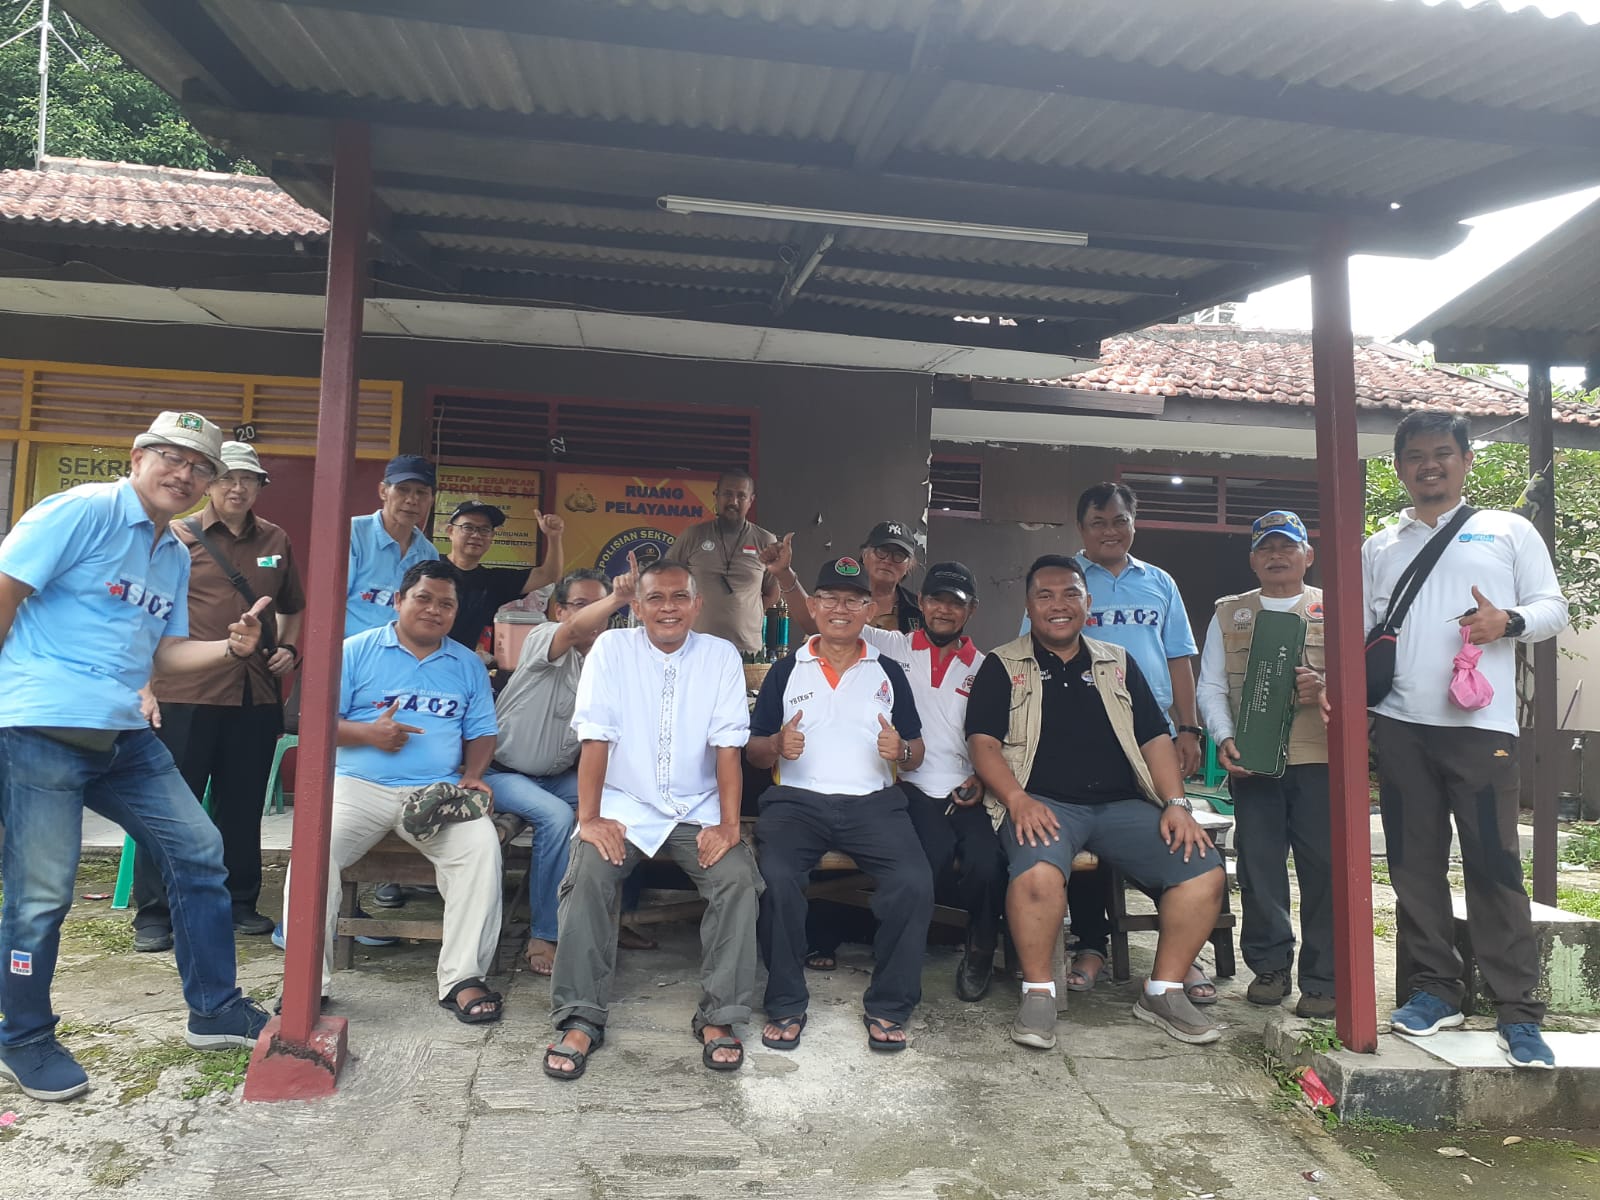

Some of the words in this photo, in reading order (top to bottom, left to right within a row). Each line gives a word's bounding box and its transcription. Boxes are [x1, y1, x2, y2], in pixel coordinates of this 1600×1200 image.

[236, 425, 256, 441] 20
[549, 436, 566, 454] 22
[440, 474, 474, 483] TETAP
[477, 476, 535, 486] TERAPKAN
[438, 483, 503, 497] PROKES
[524, 487, 537, 500] M
[625, 484, 684, 500] RUANG
[604, 500, 704, 517] PELAYANAN
